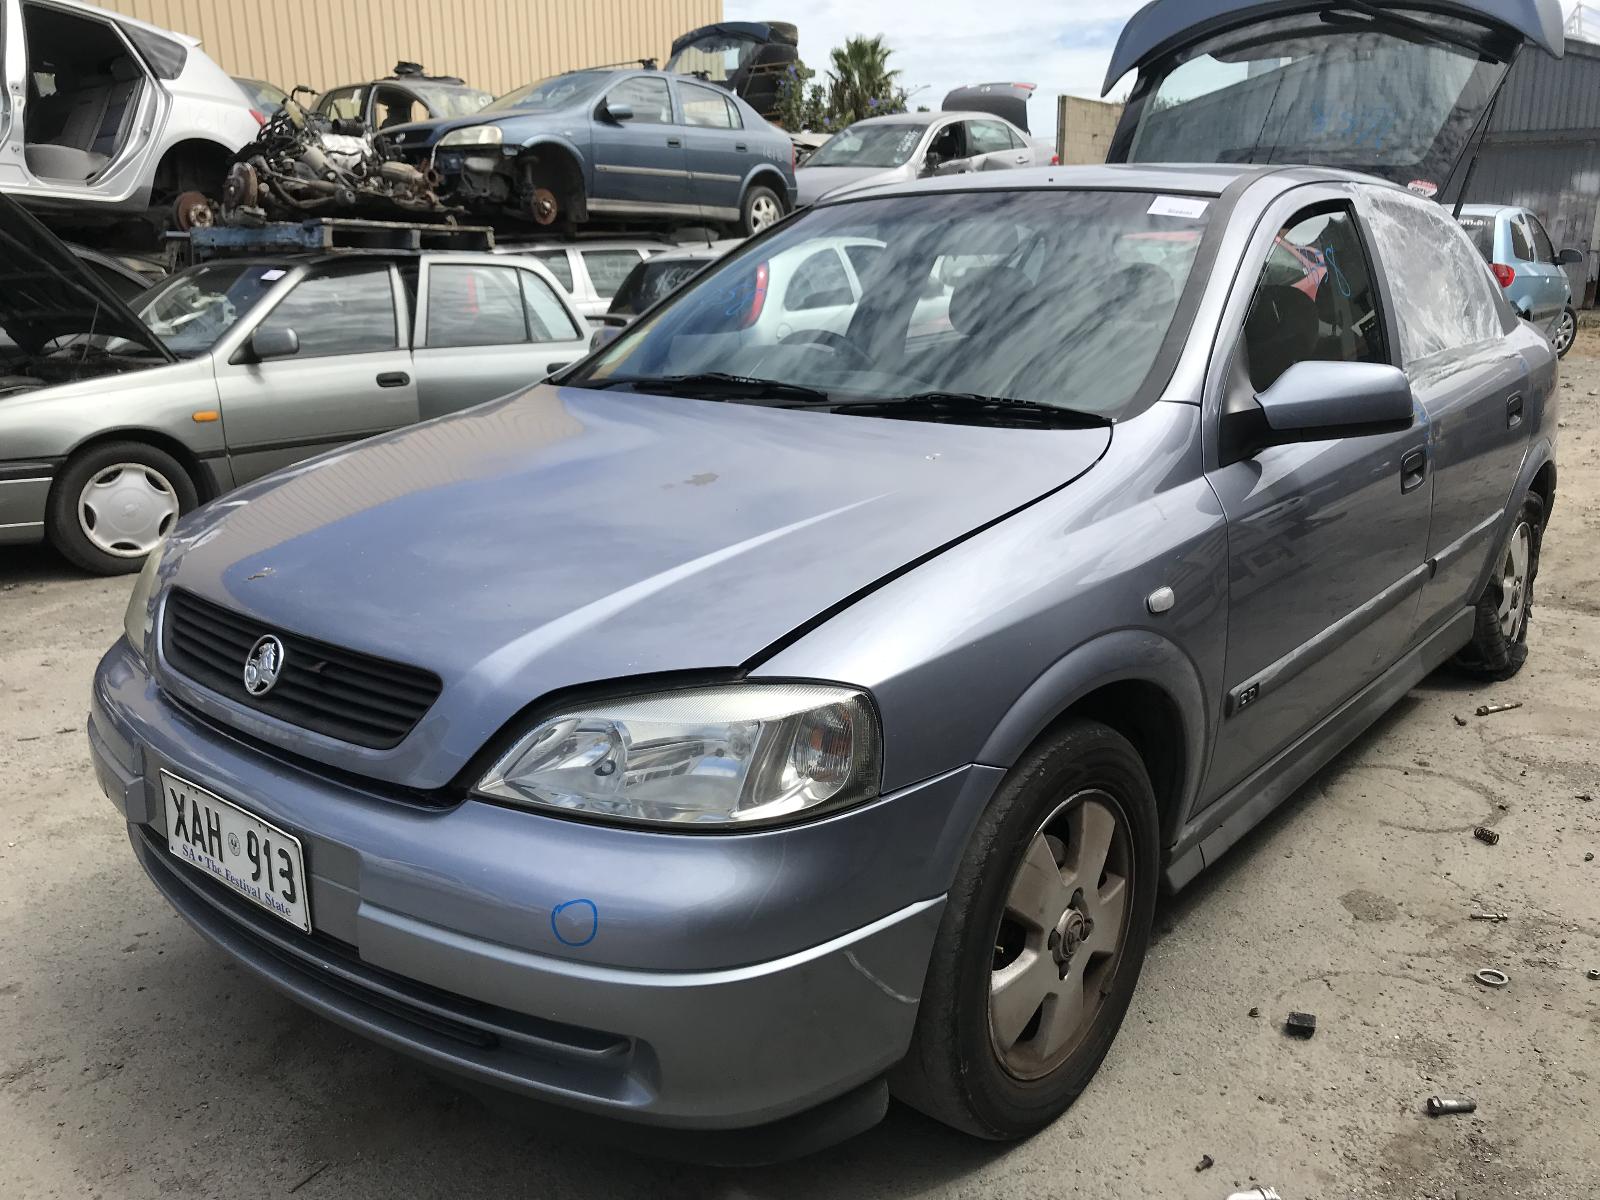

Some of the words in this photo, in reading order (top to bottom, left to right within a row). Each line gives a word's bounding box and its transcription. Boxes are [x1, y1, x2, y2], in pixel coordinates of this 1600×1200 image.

[169, 787, 224, 863] XAH
[246, 829, 297, 904] 913
[182, 843, 198, 861] SA
[204, 856, 222, 876] The
[225, 868, 261, 900] Festival
[264, 893, 292, 917] State
